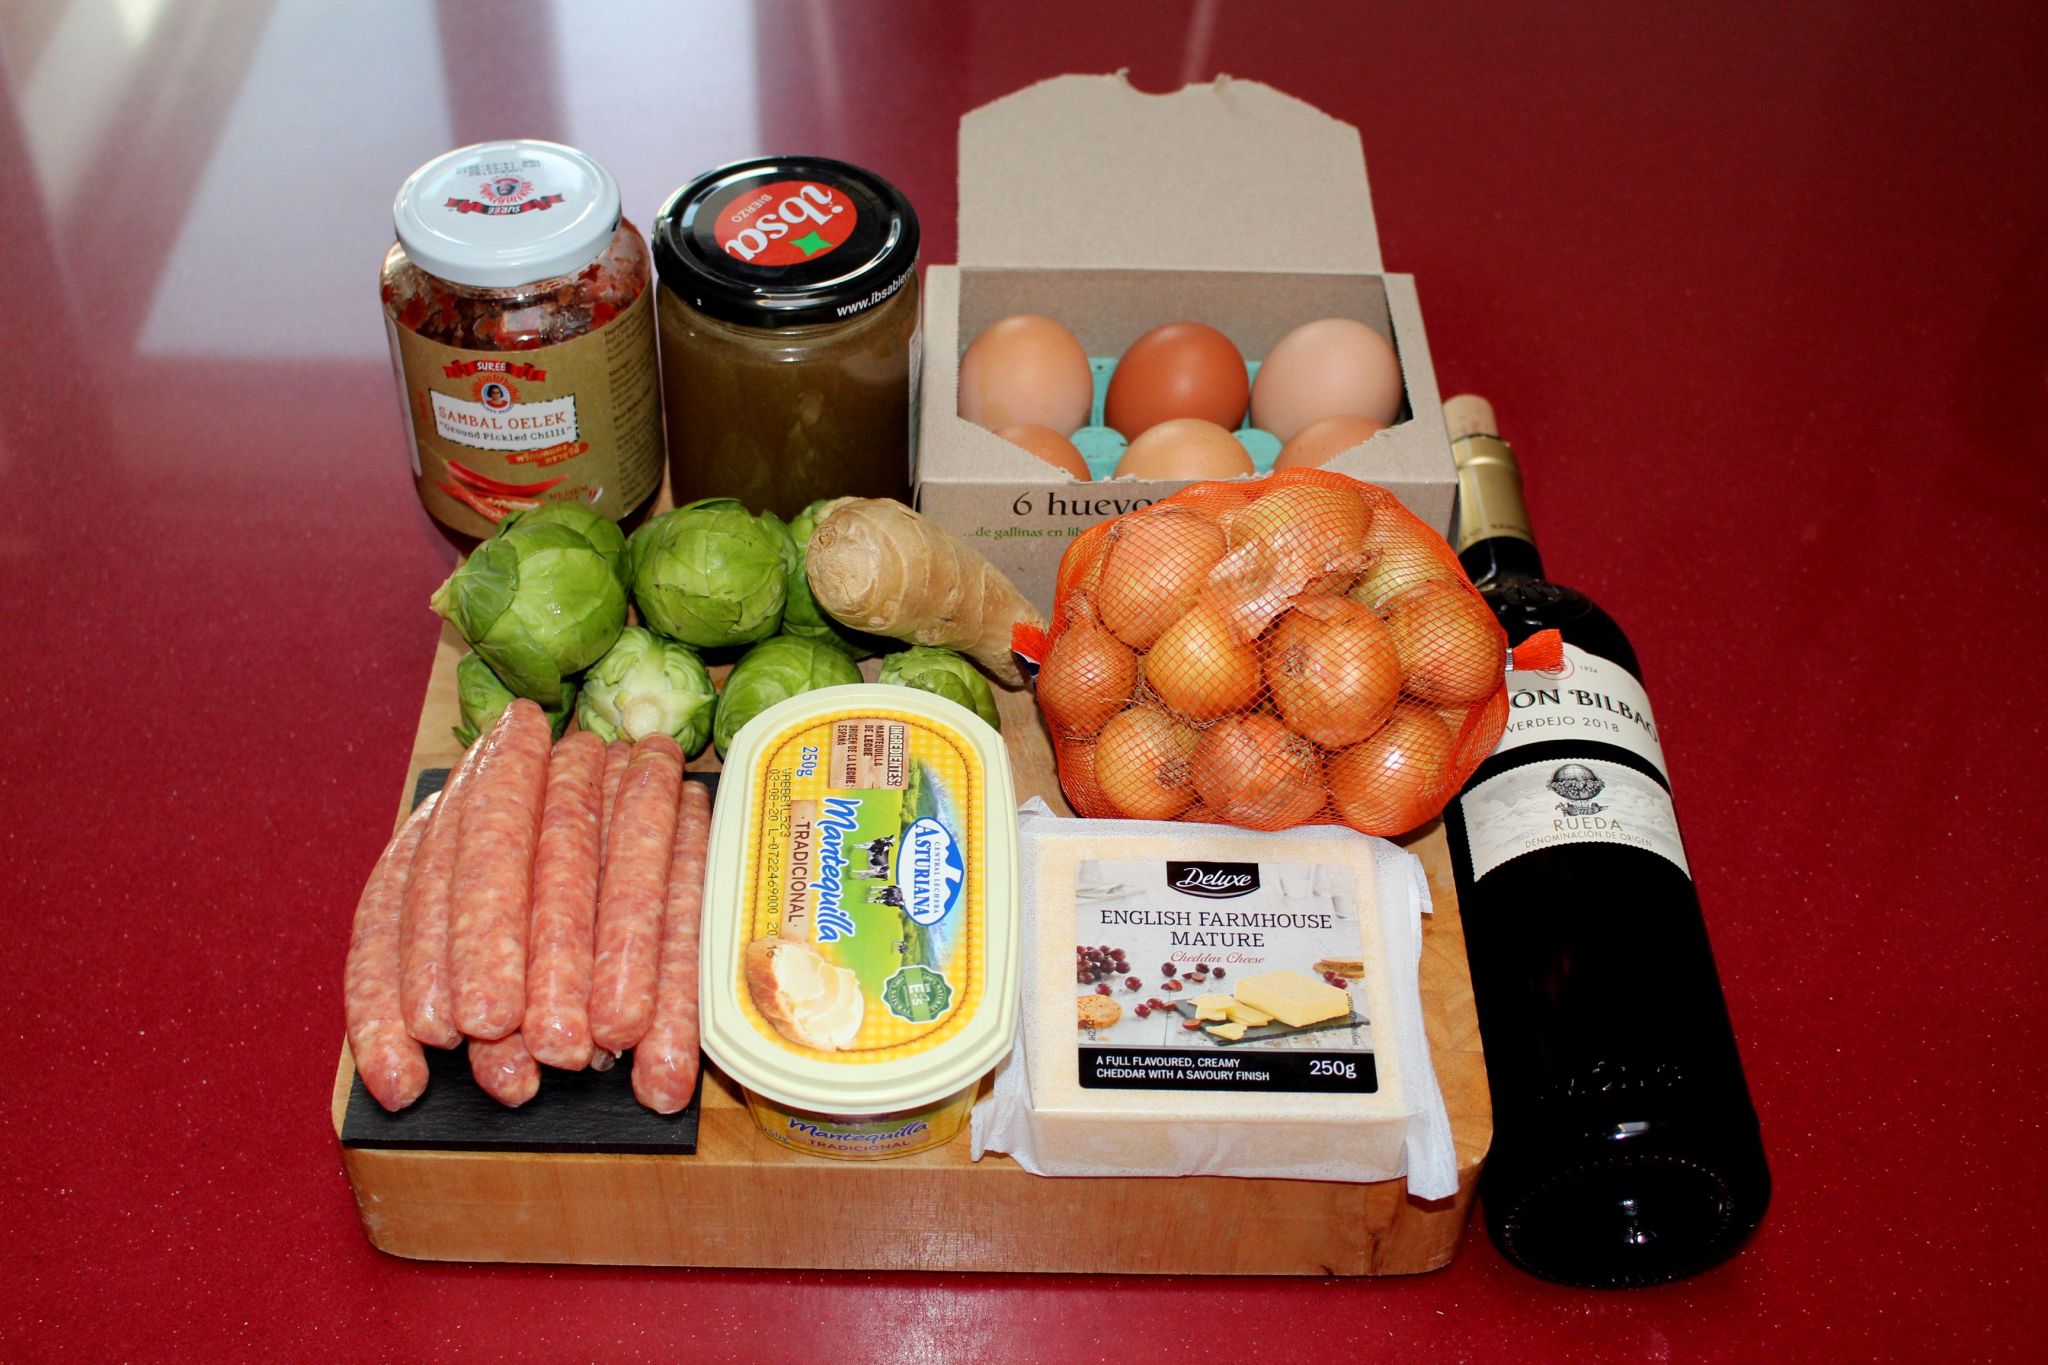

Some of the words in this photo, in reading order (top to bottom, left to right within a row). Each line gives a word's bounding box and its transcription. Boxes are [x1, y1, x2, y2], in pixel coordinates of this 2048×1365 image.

[731, 193, 773, 223] BIERZO
[725, 184, 844, 261] ibsa
[477, 360, 507, 373] SUREE
[438, 406, 503, 430] SAMBAL
[508, 411, 567, 430] OELEK
[483, 430, 527, 442] Pickled
[1013, 491, 1032, 516] 6
[1048, 492, 1166, 516] huevo
[994, 526, 1043, 541] gallinas
[1047, 529, 1063, 538] en
[848, 724, 858, 745] ORIGEN
[864, 724, 873, 733] DE
[1506, 716, 1575, 733] VERDEJO
[1583, 716, 1620, 733] 2018
[848, 745, 857, 753] DE
[863, 734, 873, 757] LECHE
[873, 724, 885, 767] MANTEQUILLA
[887, 725, 904, 786] INGREDIENTES:
[796, 746, 818, 778] 250g
[847, 754, 856, 762] LA
[1552, 816, 1623, 832] RUEDA
[1525, 829, 1602, 848] DENOMINACIÓN
[1605, 831, 1617, 839] DE
[1620, 832, 1652, 847] ORIGEN
[933, 842, 941, 876] CENTRAL
[789, 821, 811, 922] TRADICIONAL
[810, 798, 862, 943] Mantequilla
[914, 824, 940, 917] ASTURIANA
[1175, 867, 1252, 889] Deluxe
[933, 879, 941, 914] LECHERA
[1100, 909, 1191, 926] ENGLISH
[1198, 911, 1332, 929] FARMHOUSE
[1170, 931, 1265, 948] MATURE
[1170, 951, 1222, 964] Cheddar
[1226, 951, 1265, 965] Cheese
[1096, 1055, 1104, 1066] A
[1106, 1055, 1131, 1067] FULL
[1133, 1056, 1195, 1069] FLAVOURED,
[1197, 1057, 1240, 1068] CREAMY
[1309, 1060, 1357, 1079] 250g
[1096, 1068, 1146, 1079] CHEDDAR
[1148, 1069, 1175, 1080] WITH
[1177, 1069, 1184, 1080] A
[1186, 1070, 1234, 1081] SAVOURY
[1236, 1070, 1270, 1081] FINISH
[789, 1117, 928, 1144] Mantequilla
[808, 1138, 911, 1152] TRADICIONAL
